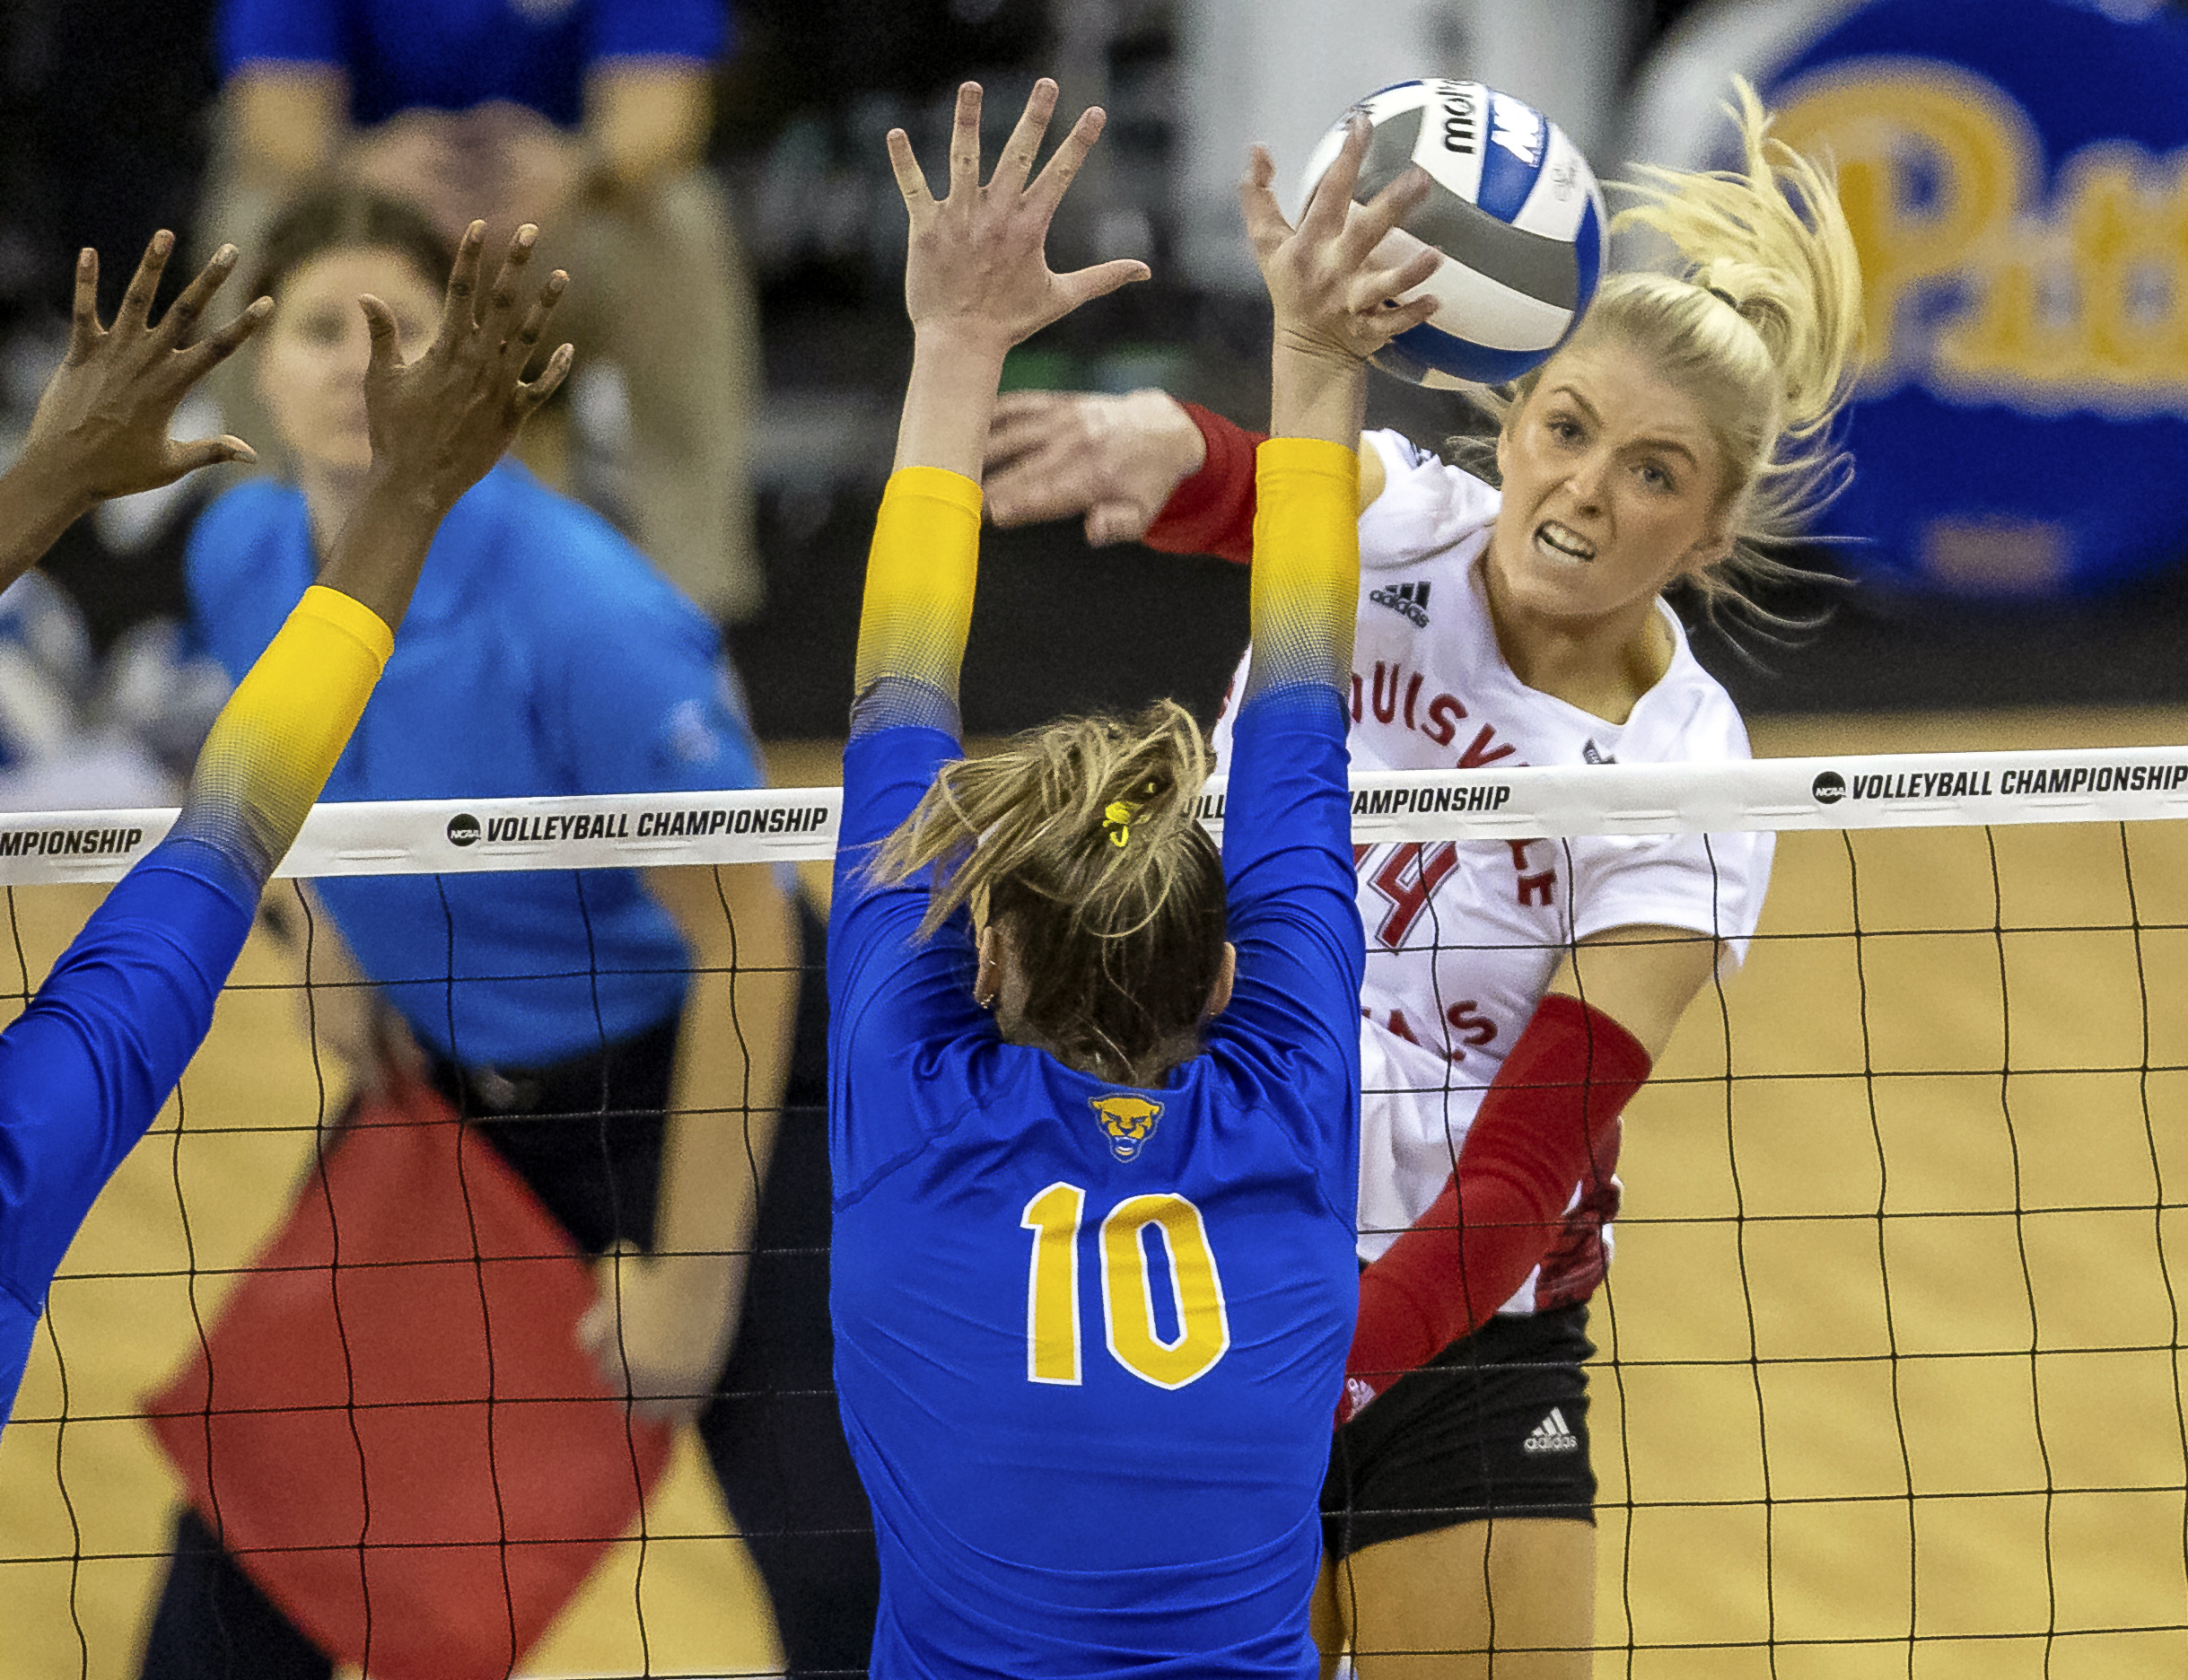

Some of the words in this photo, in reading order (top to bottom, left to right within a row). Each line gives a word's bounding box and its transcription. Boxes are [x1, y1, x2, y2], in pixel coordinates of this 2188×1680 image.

[1370, 589, 1430, 629] adidas
[1349, 785, 1511, 815] AMPIONSHIP
[1851, 770, 1993, 800] VOLLEYBALL
[2000, 765, 2188, 795] CHAMPIONSHIP
[0, 827, 144, 857] MPIONSHIP
[487, 812, 629, 842] VOLLEYBALL
[636, 807, 828, 837] CHAMPIONSHIP
[1020, 1180, 1231, 1391] 10
[1523, 1432, 1579, 1453] adidas
